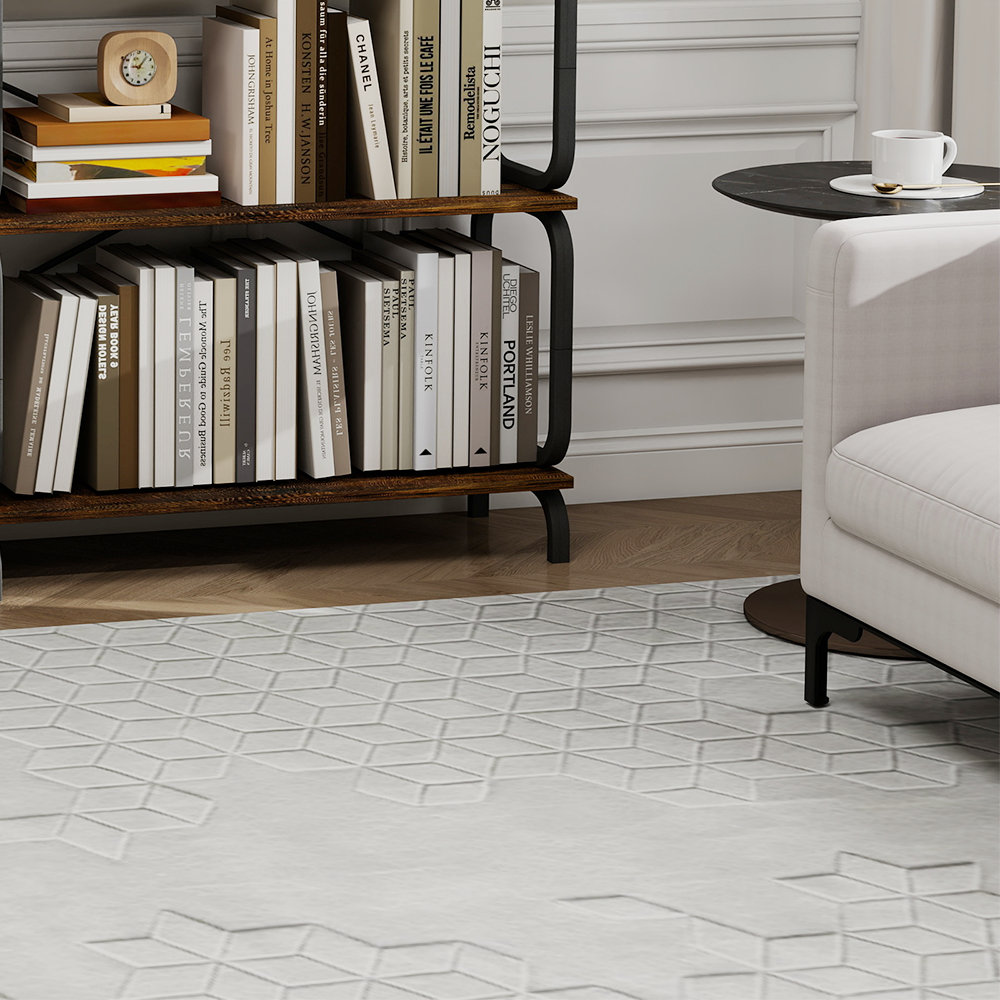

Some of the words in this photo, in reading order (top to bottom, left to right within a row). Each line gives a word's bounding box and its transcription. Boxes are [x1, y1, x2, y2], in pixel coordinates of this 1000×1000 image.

[266, 37, 272, 47] At
[418, 35, 434, 59] CAFÉ
[302, 33, 311, 93] KONSTEN
[356, 34, 372, 92] CHANEL
[420, 62, 433, 72] LE
[266, 80, 271, 88] in
[420, 74, 433, 95] FOIS
[263, 91, 273, 121] Joshua
[420, 97, 433, 116] UNE
[464, 66, 476, 140] Remodelista
[483, 45, 500, 162] NOGUCHI
[416, 120, 432, 145] ÉTAIT
[419, 145, 432, 154] IL
[502, 274, 510, 319] UCHITEL
[525, 314, 534, 345] LESLIE
[424, 333, 433, 391] KINFOLK
[503, 340, 516, 430] PORTLAND
[525, 347, 534, 415] WHILLIAMSON
